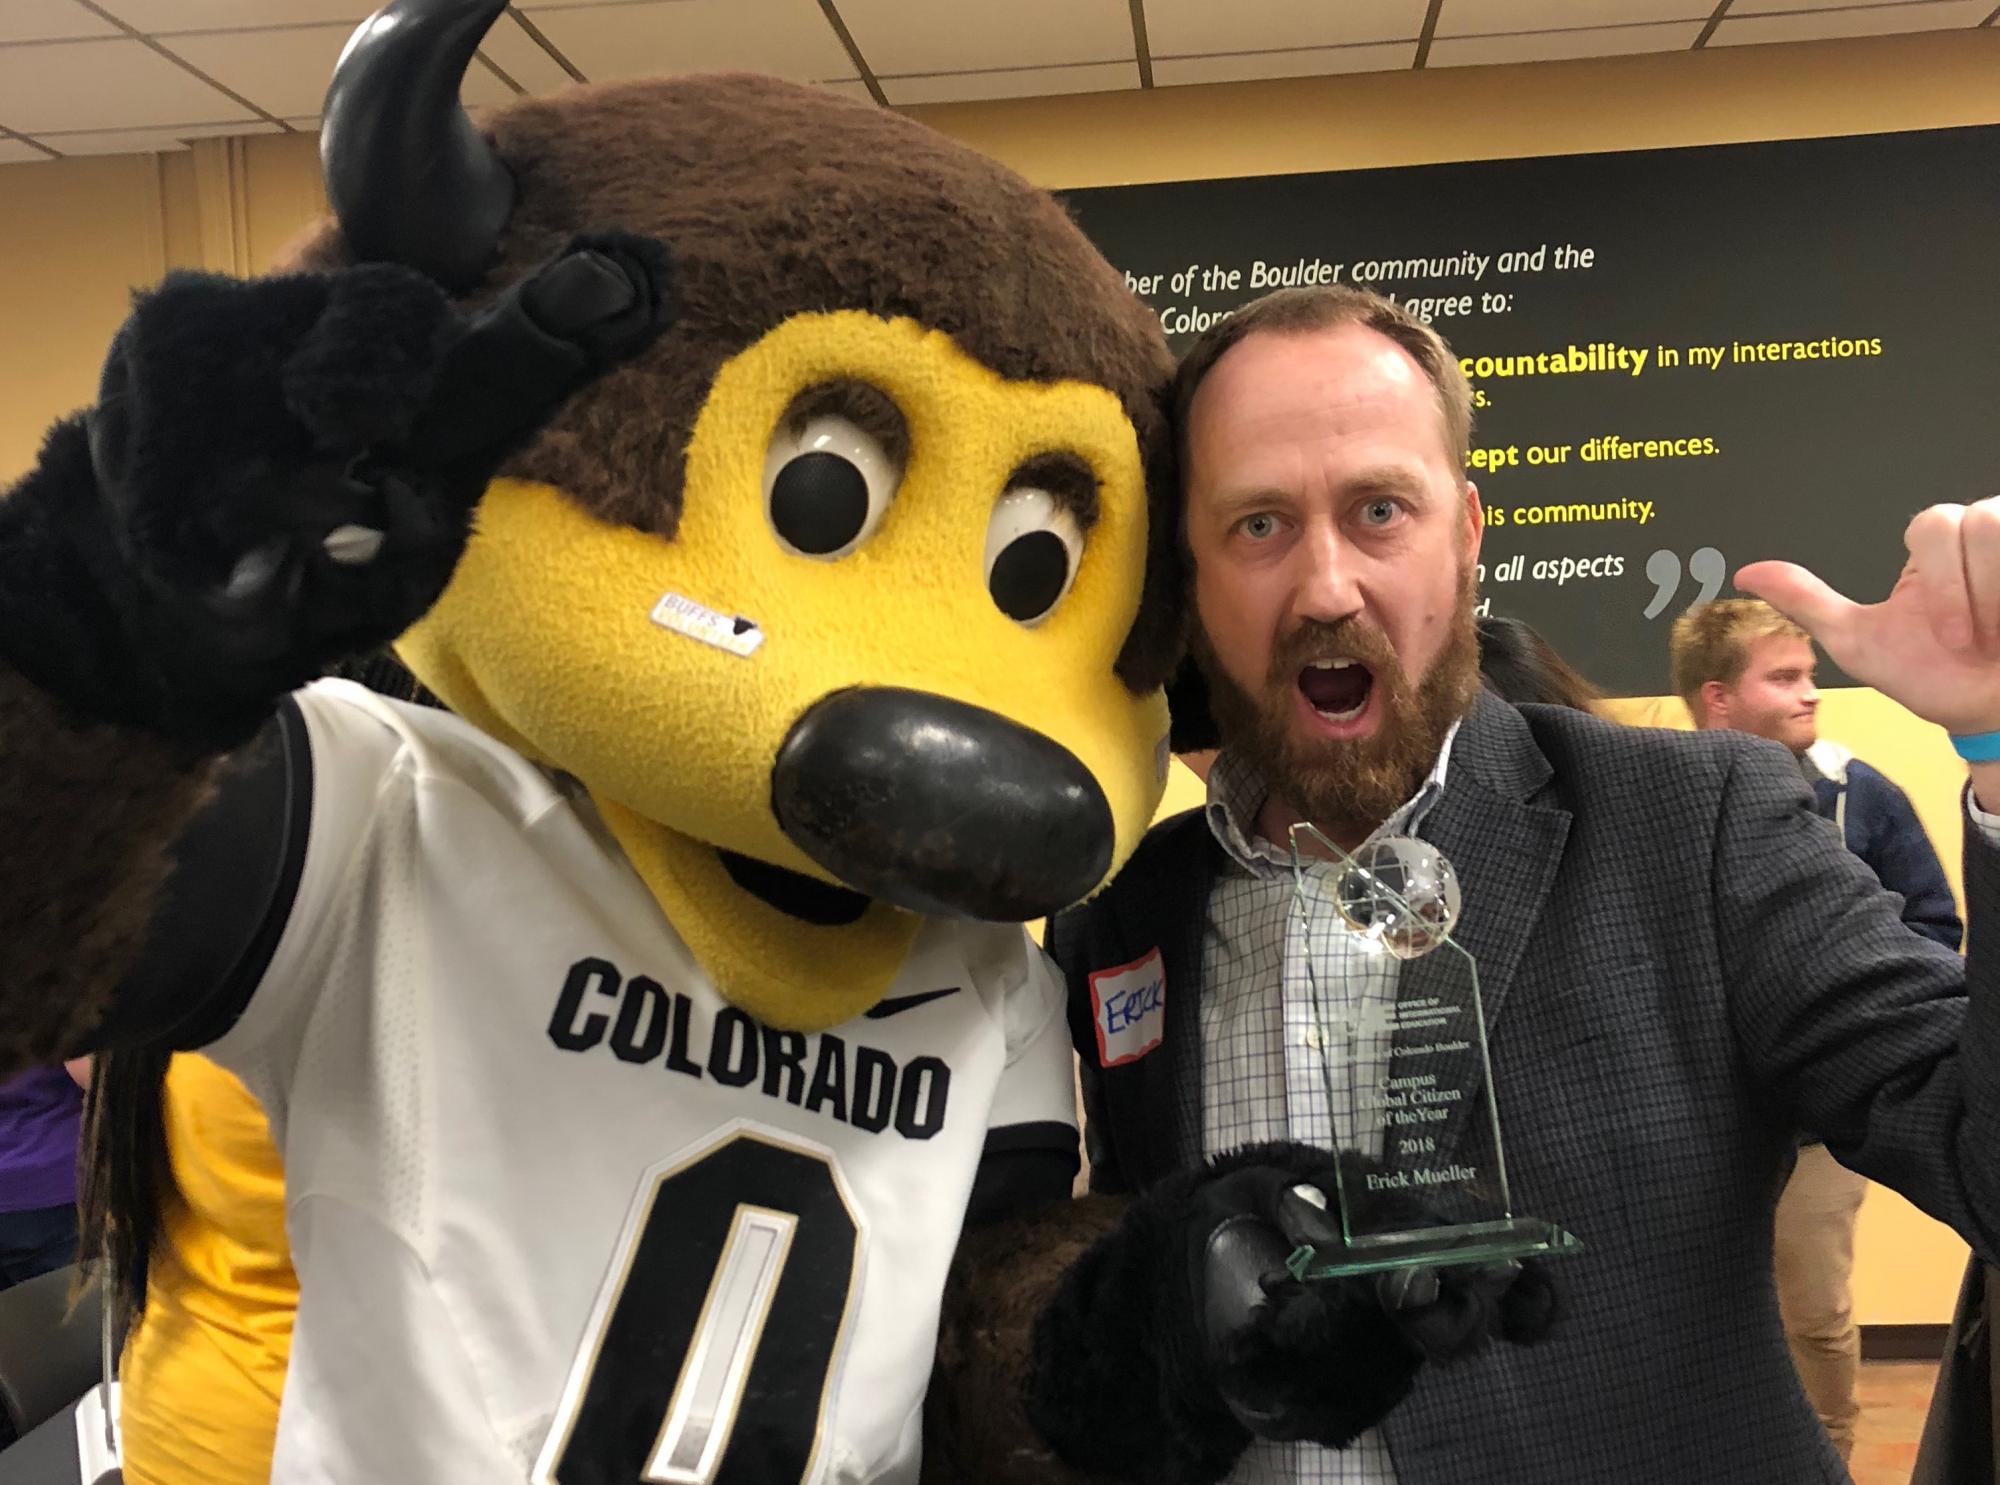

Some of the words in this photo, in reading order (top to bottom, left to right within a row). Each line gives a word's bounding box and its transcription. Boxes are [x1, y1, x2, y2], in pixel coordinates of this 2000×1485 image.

[1171, 265, 1199, 297] of
[1202, 264, 1241, 291] the
[1250, 259, 1343, 288] Boulder
[1352, 250, 1490, 281] community
[1497, 244, 1546, 273] and
[1554, 243, 1594, 270] the
[1404, 295, 1473, 324] agree
[1481, 292, 1513, 314] to:
[1459, 343, 1649, 378] countability
[1657, 345, 1679, 368] in
[1688, 345, 1726, 370] my
[1733, 336, 1883, 363] interactions
[1526, 444, 1572, 466] our
[1580, 435, 1720, 463] differences.
[1513, 497, 1656, 525] community.
[1494, 554, 1525, 582] all
[1532, 554, 1625, 586] aspects
[547, 956, 951, 1141] COLORADO
[1379, 1074, 1437, 1090] Campus
[1410, 1088, 1462, 1104] Citizen
[1399, 1136, 1436, 1154] 2018
[1366, 1170, 1410, 1191] Erick
[1413, 1164, 1477, 1186] Mueller
